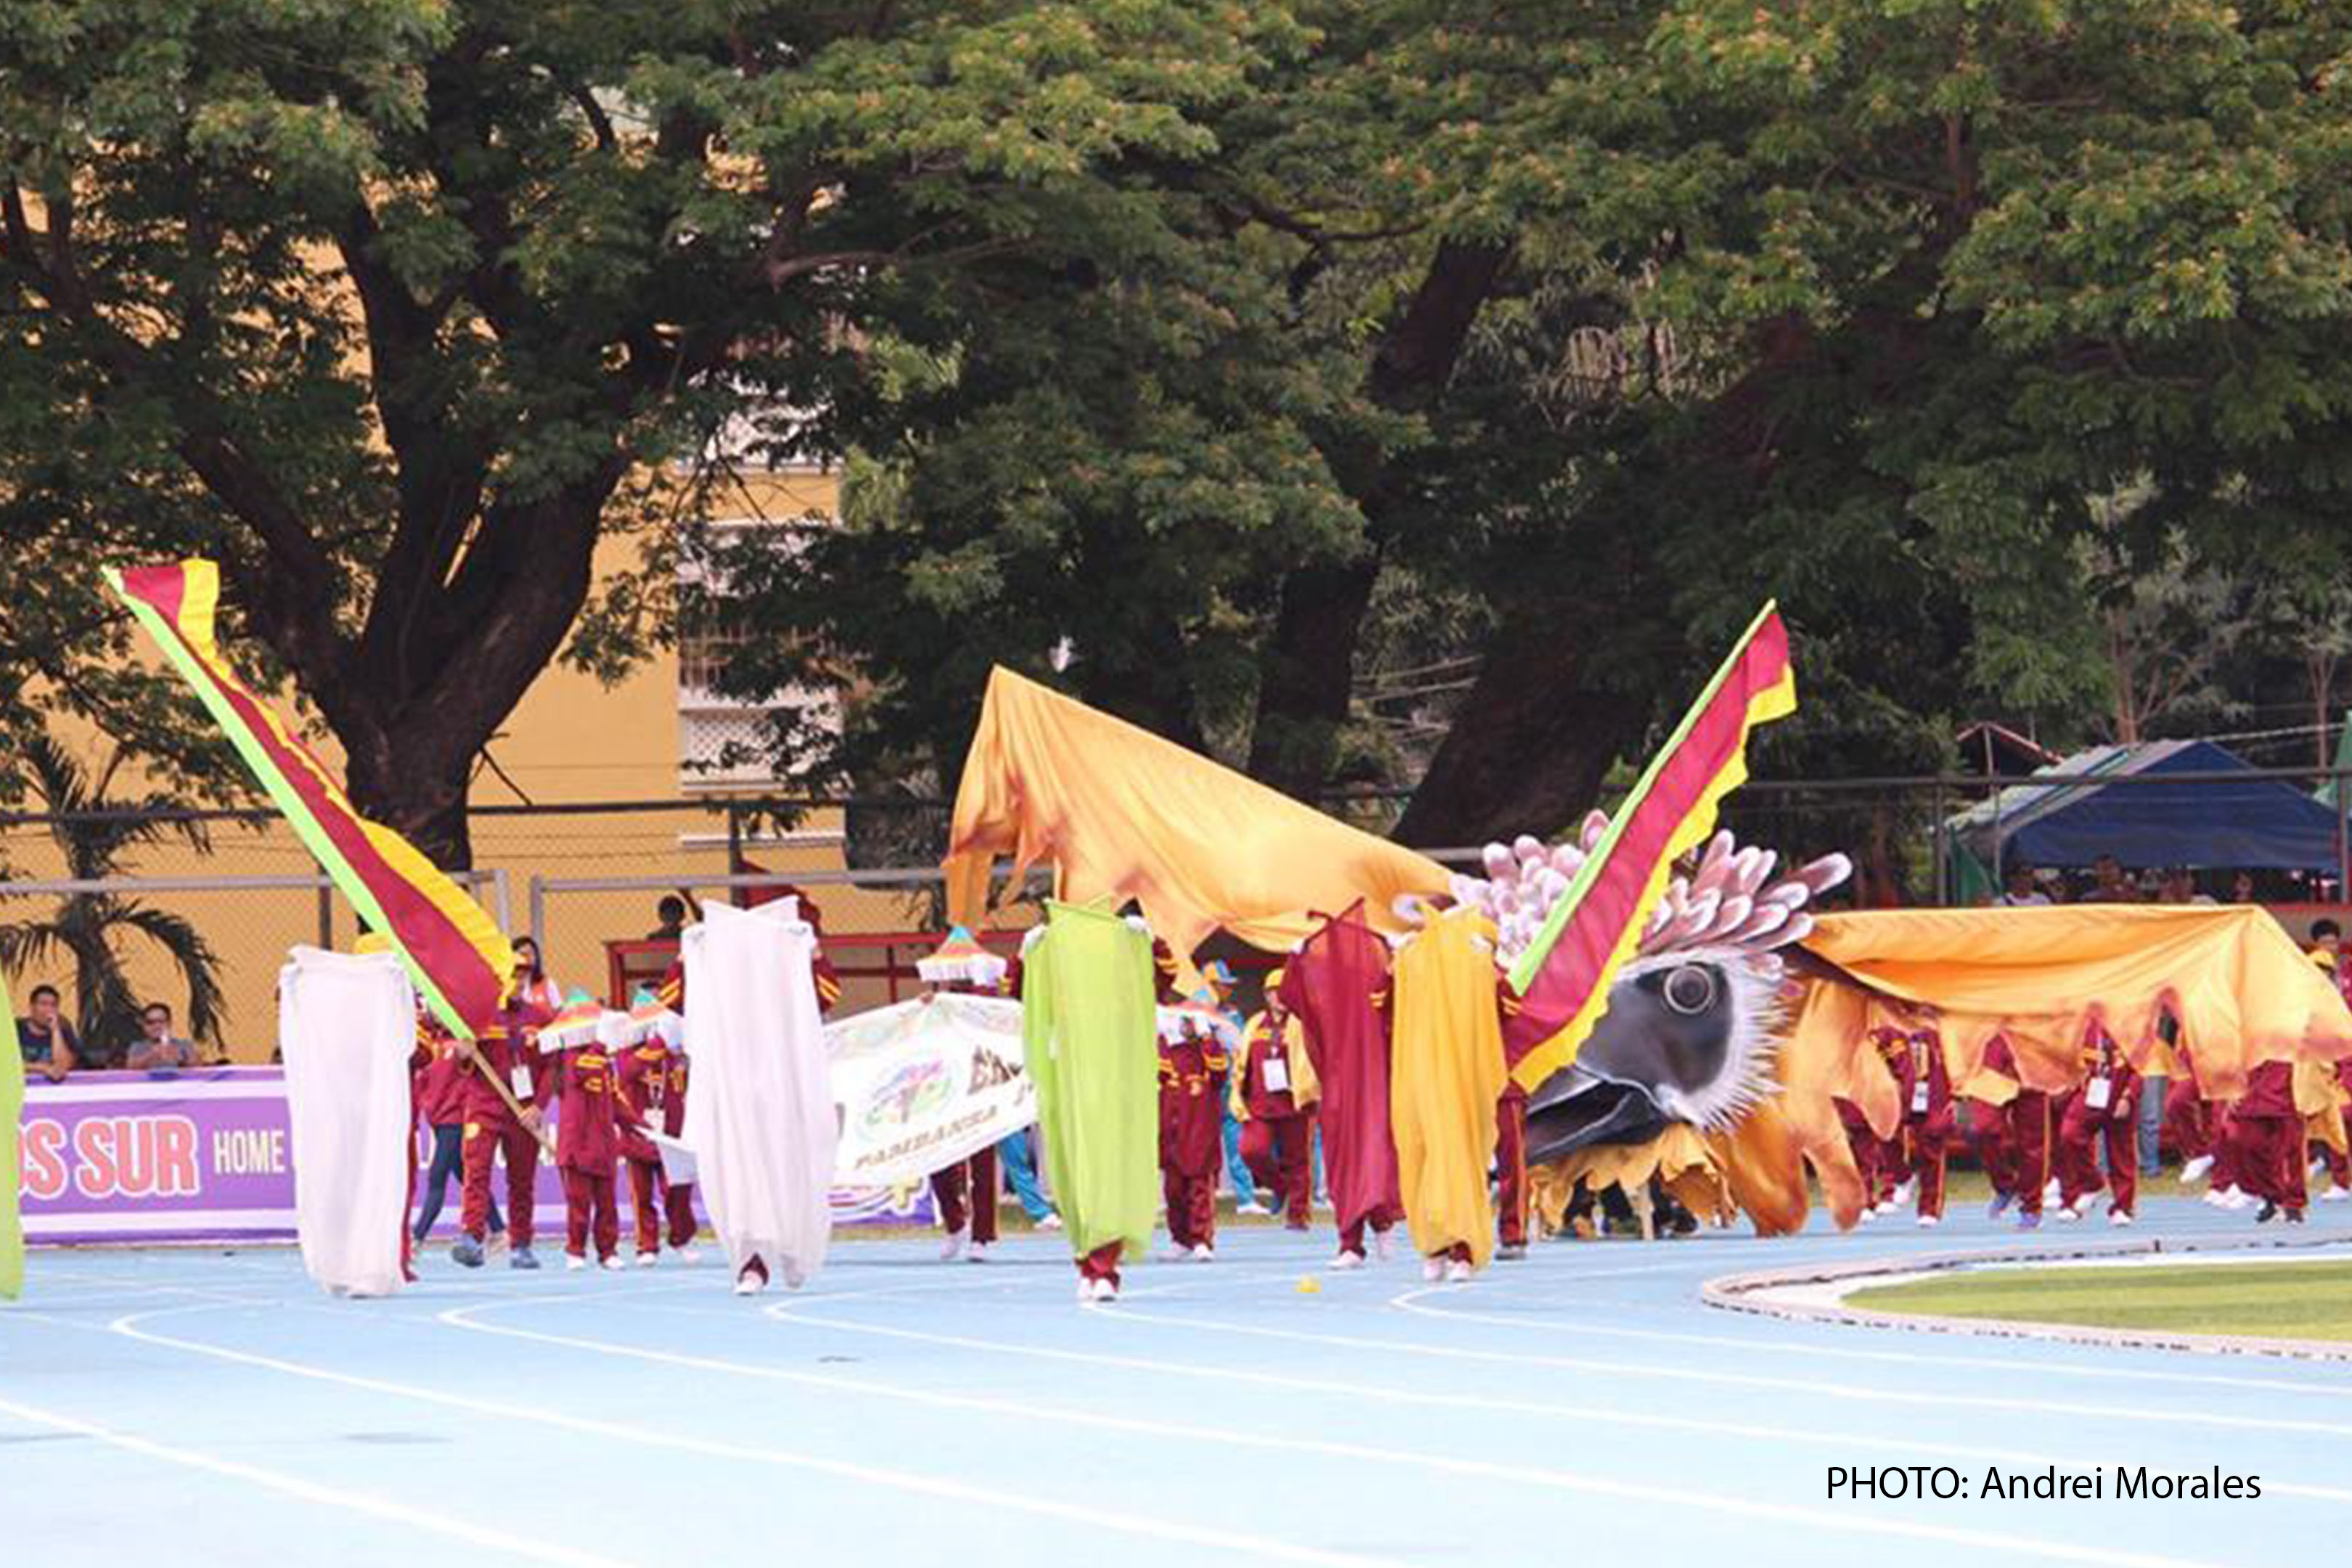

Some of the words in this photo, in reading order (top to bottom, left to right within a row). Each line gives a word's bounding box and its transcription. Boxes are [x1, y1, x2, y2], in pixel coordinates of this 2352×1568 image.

[19, 1119, 68, 1200] S
[75, 1114, 200, 1199] SUR
[213, 1129, 286, 1175] HOME
